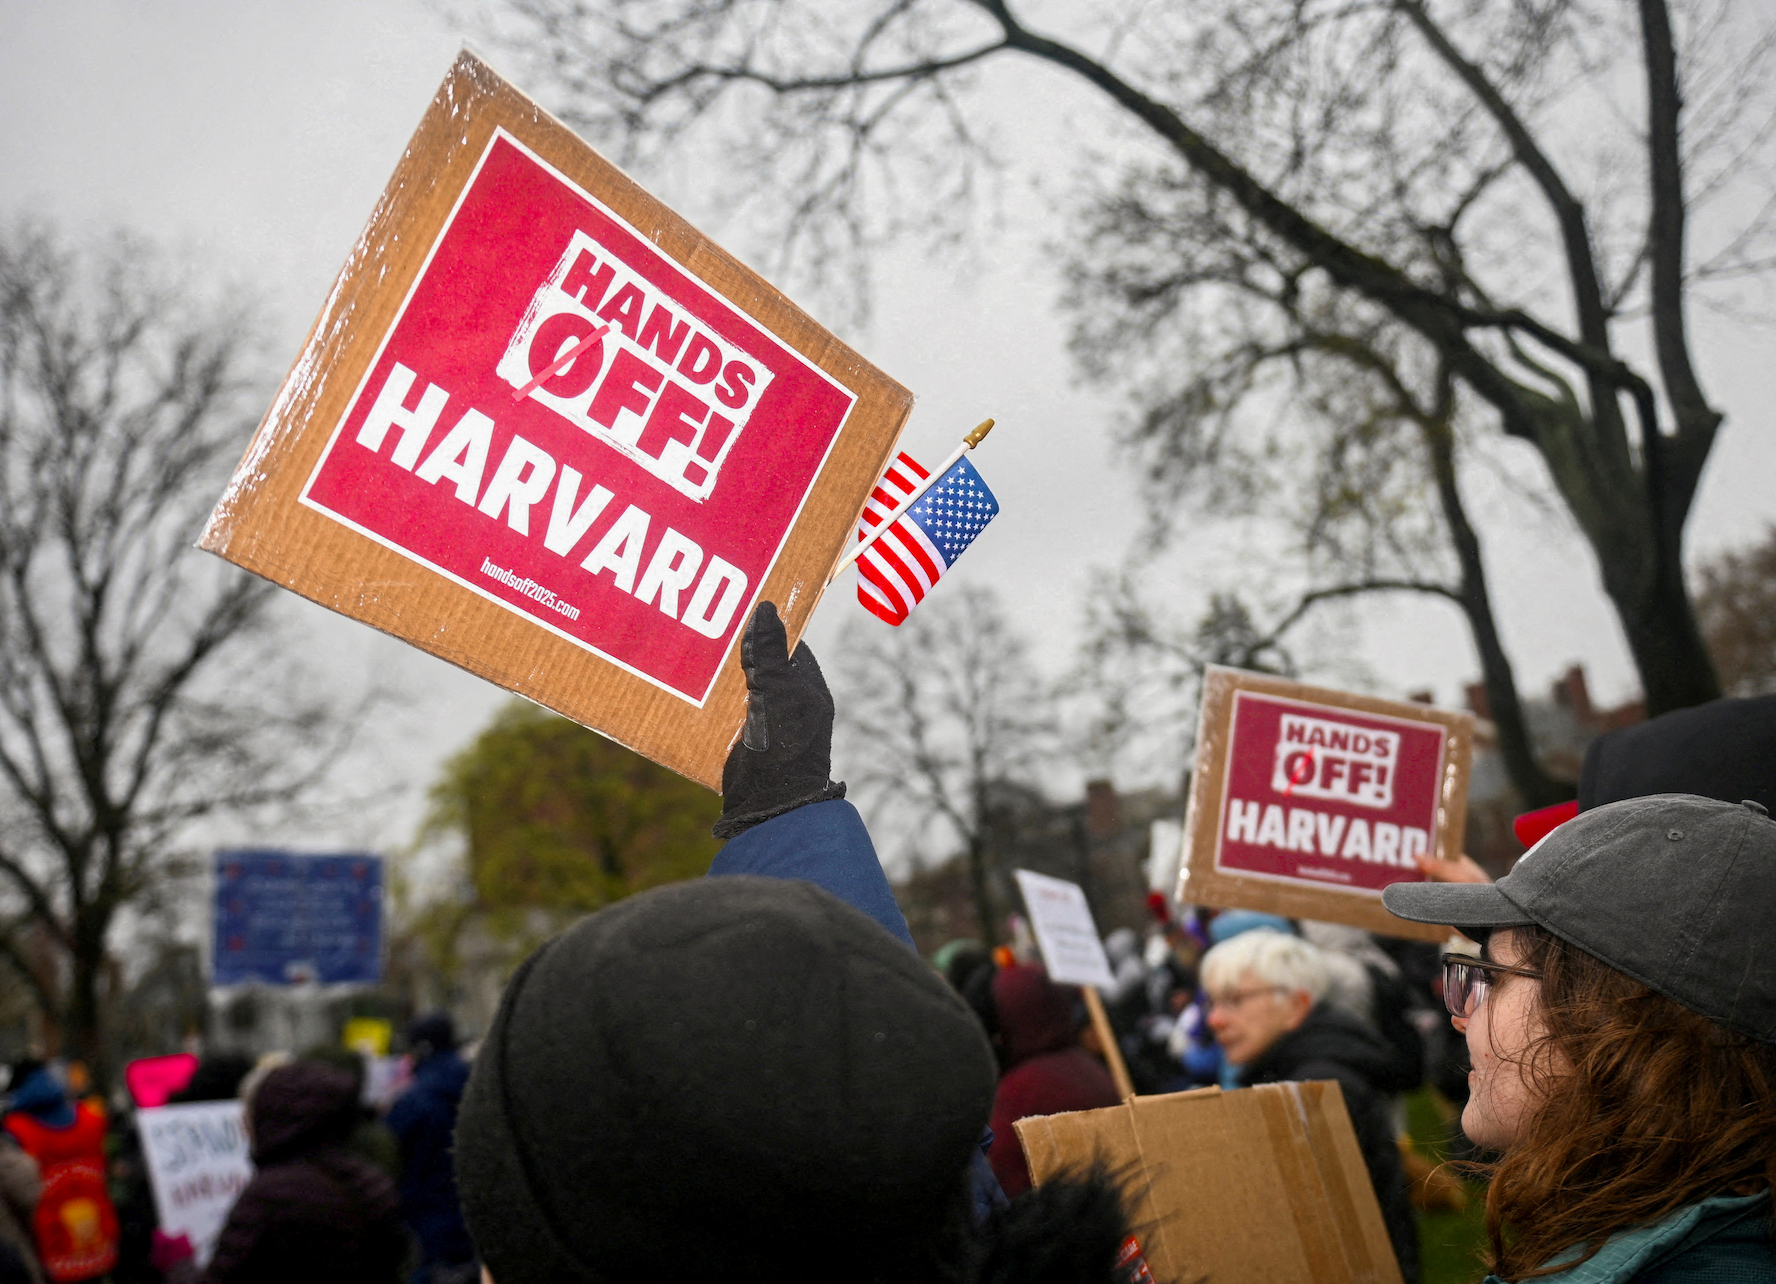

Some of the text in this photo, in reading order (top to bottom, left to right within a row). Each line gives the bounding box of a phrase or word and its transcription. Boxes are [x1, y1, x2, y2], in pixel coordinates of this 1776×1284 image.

[561, 249, 757, 409] HANDS
[527, 313, 736, 486] OFF!
[355, 362, 749, 640] HARVARD
[480, 556, 580, 621] handsoff2025.com
[1287, 722, 1391, 758] HANDS
[1285, 752, 1388, 799] OFF!
[1228, 799, 1428, 868] HARVARD
